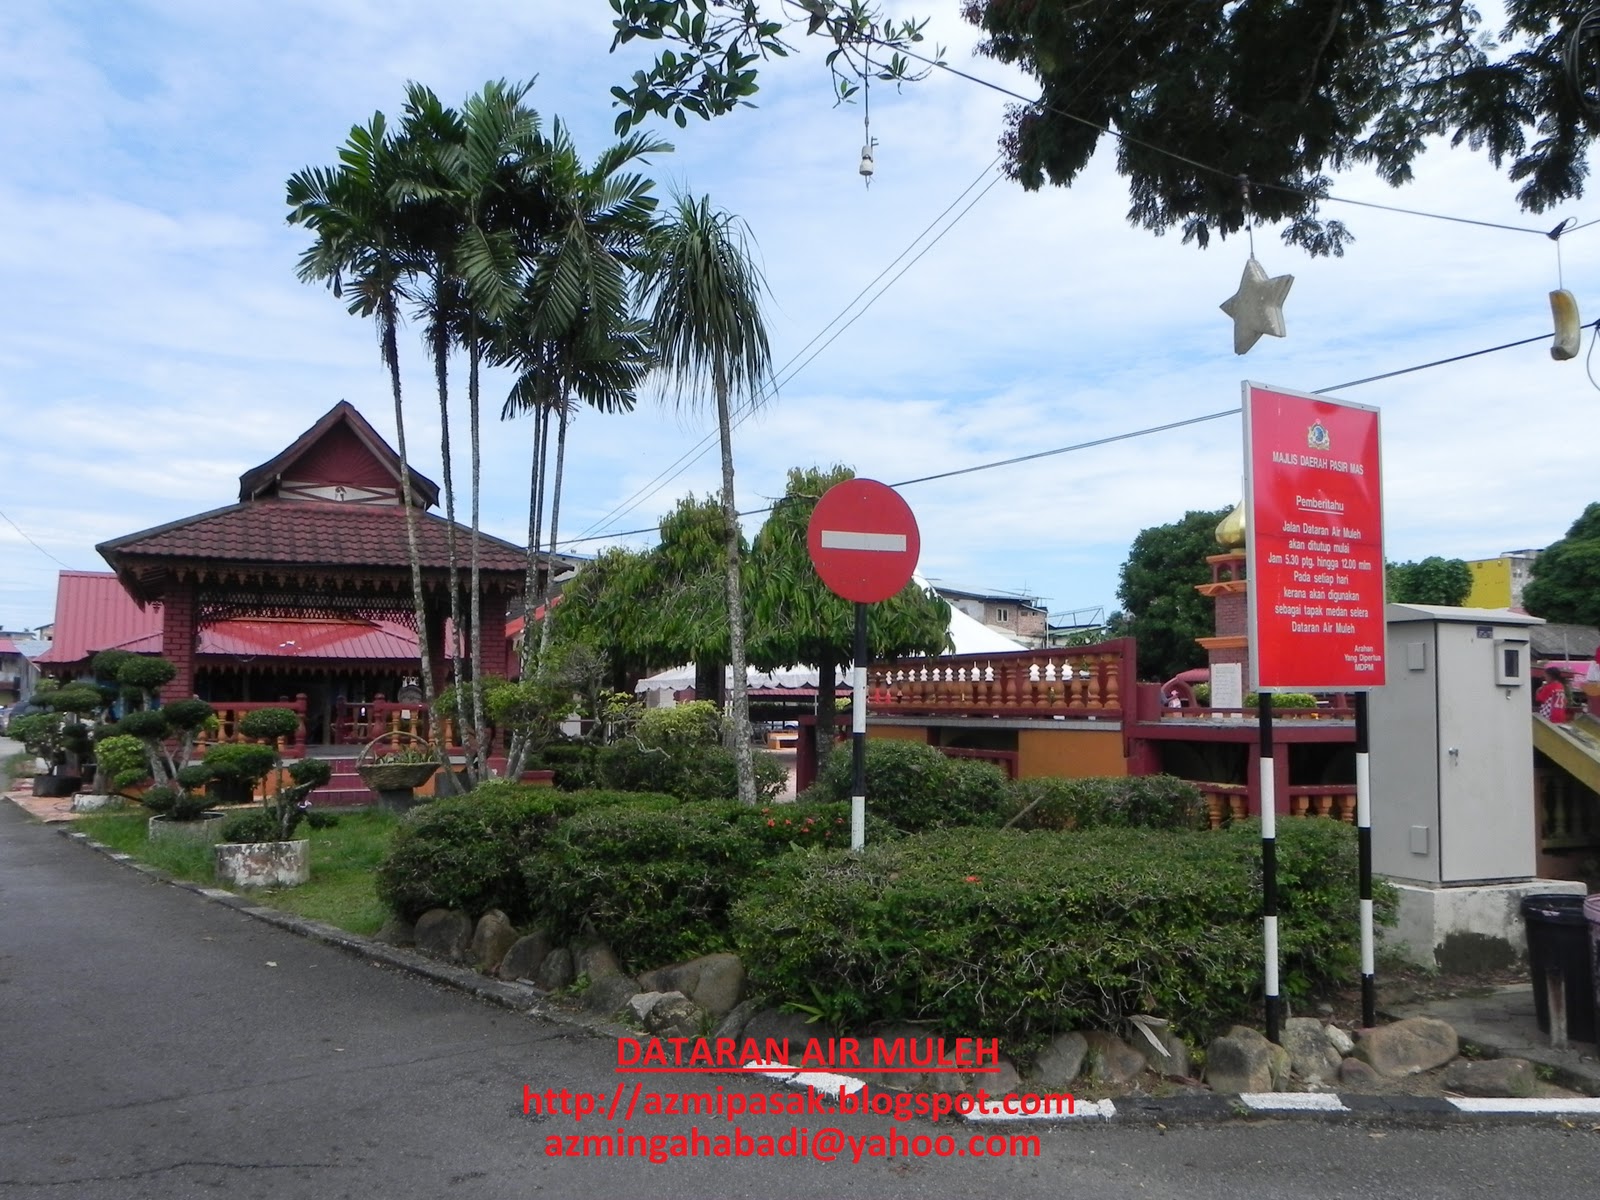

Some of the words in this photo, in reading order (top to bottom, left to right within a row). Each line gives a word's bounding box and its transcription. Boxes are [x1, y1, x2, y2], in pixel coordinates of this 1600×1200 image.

[1272, 451, 1298, 465] MAJLIS
[1300, 455, 1328, 469] DAERAH
[1330, 460, 1348, 472] PASIR
[1350, 463, 1364, 475] MAS
[1296, 495, 1344, 511] Pemberitahu
[1283, 521, 1300, 532] Jalan
[1303, 523, 1329, 536] Dataran
[1332, 526, 1341, 537] Air
[1343, 527, 1361, 539] Muleh
[1289, 539, 1305, 550] akan
[1308, 541, 1331, 554] ditutup
[1333, 543, 1350, 554] mulai
[1268, 552, 1282, 564] Jam
[1285, 554, 1299, 566] 5.30
[1317, 557, 1338, 570] hingga
[1341, 559, 1356, 569] 12.00
[1359, 561, 1371, 571] mlm
[1294, 571, 1310, 583] Pada
[1314, 573, 1334, 586] setiap
[1336, 575, 1349, 585] hari
[1284, 587, 1306, 599] kerana
[1309, 588, 1325, 600] akan
[1328, 589, 1360, 603] digunakan
[1275, 603, 1301, 617] sebagai
[1304, 605, 1323, 618] tapak
[1326, 607, 1348, 617] medan
[1350, 607, 1369, 618] selera
[1292, 621, 1319, 633] Dataran
[1323, 622, 1333, 634] Air
[1336, 623, 1355, 634] Muleh
[1344, 654, 1357, 663] Yang
[1359, 654, 1381, 662] Dipertua
[1355, 663, 1374, 671] MDPM
